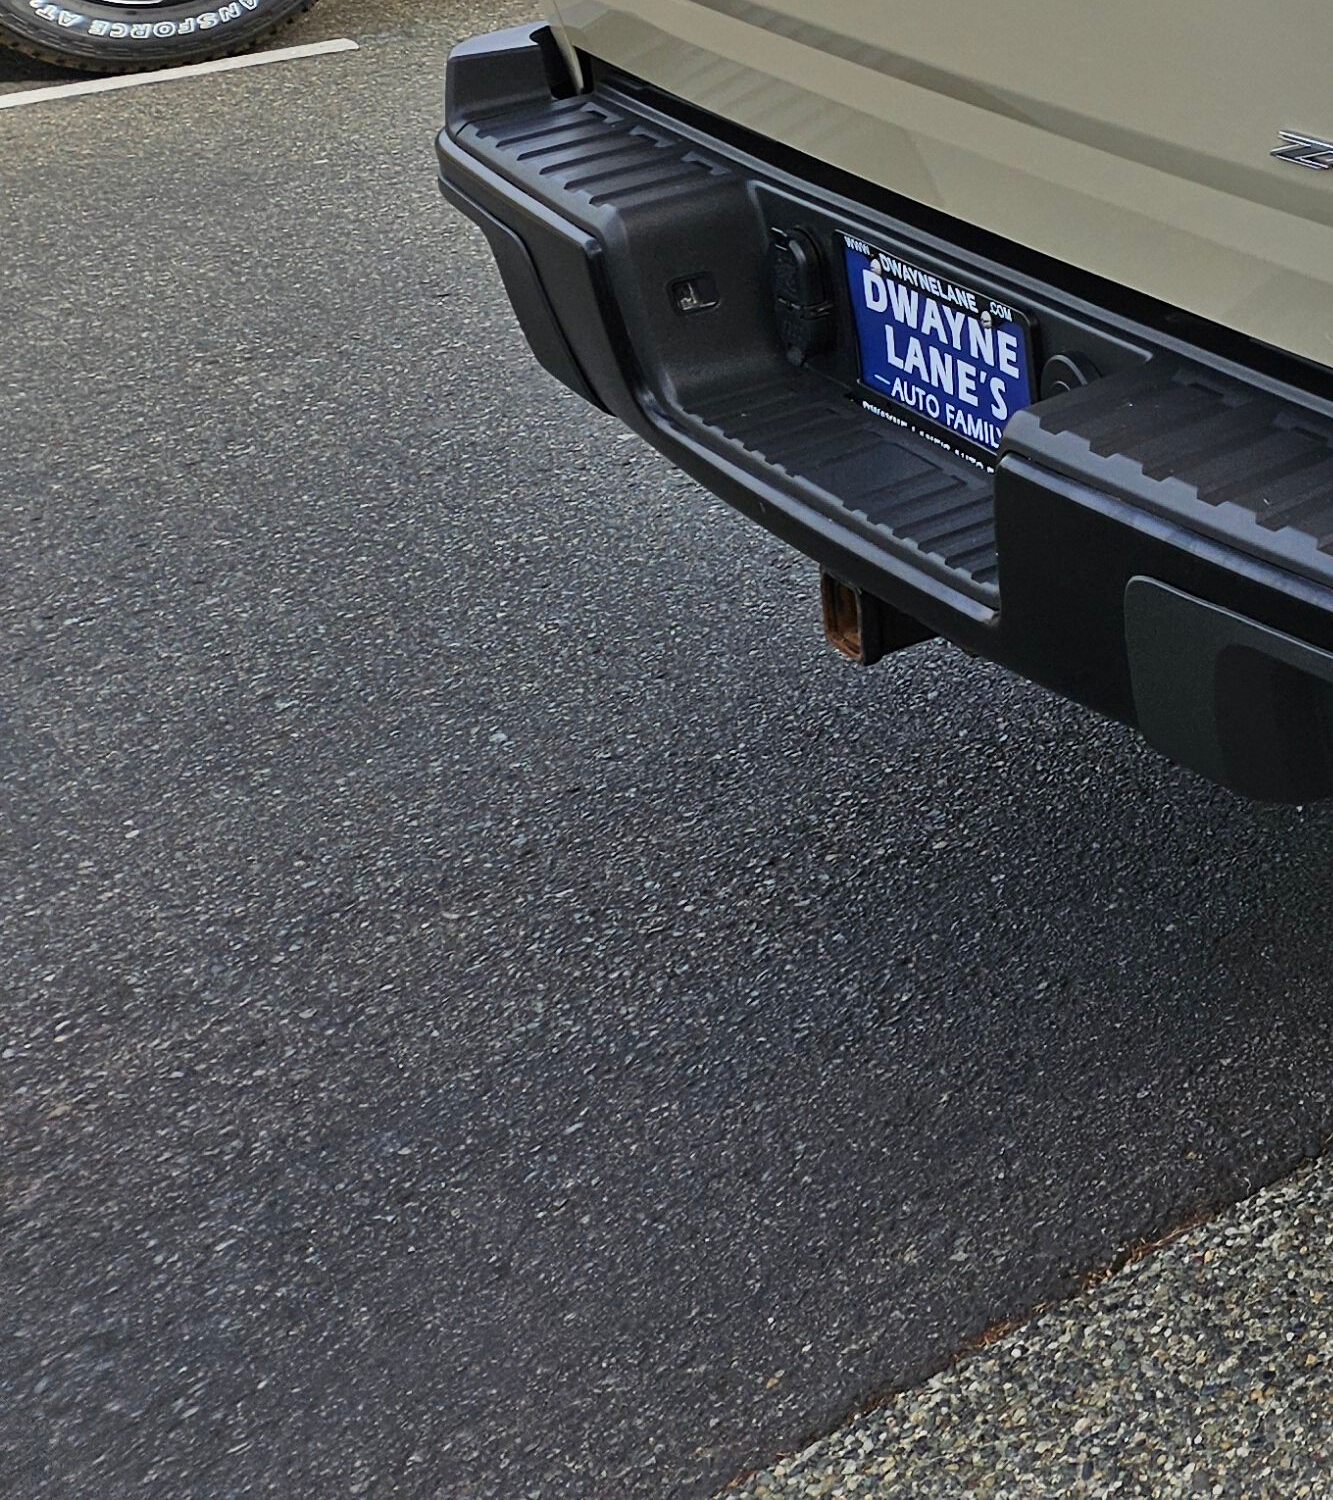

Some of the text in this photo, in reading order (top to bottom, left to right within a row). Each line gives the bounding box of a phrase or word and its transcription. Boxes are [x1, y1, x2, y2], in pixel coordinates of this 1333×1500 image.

[878, 252, 979, 313] DWAYNELANE
[862, 268, 1020, 379] DWAYNE
[884, 323, 1009, 421] LANE'S
[890, 376, 940, 439] AUTO
